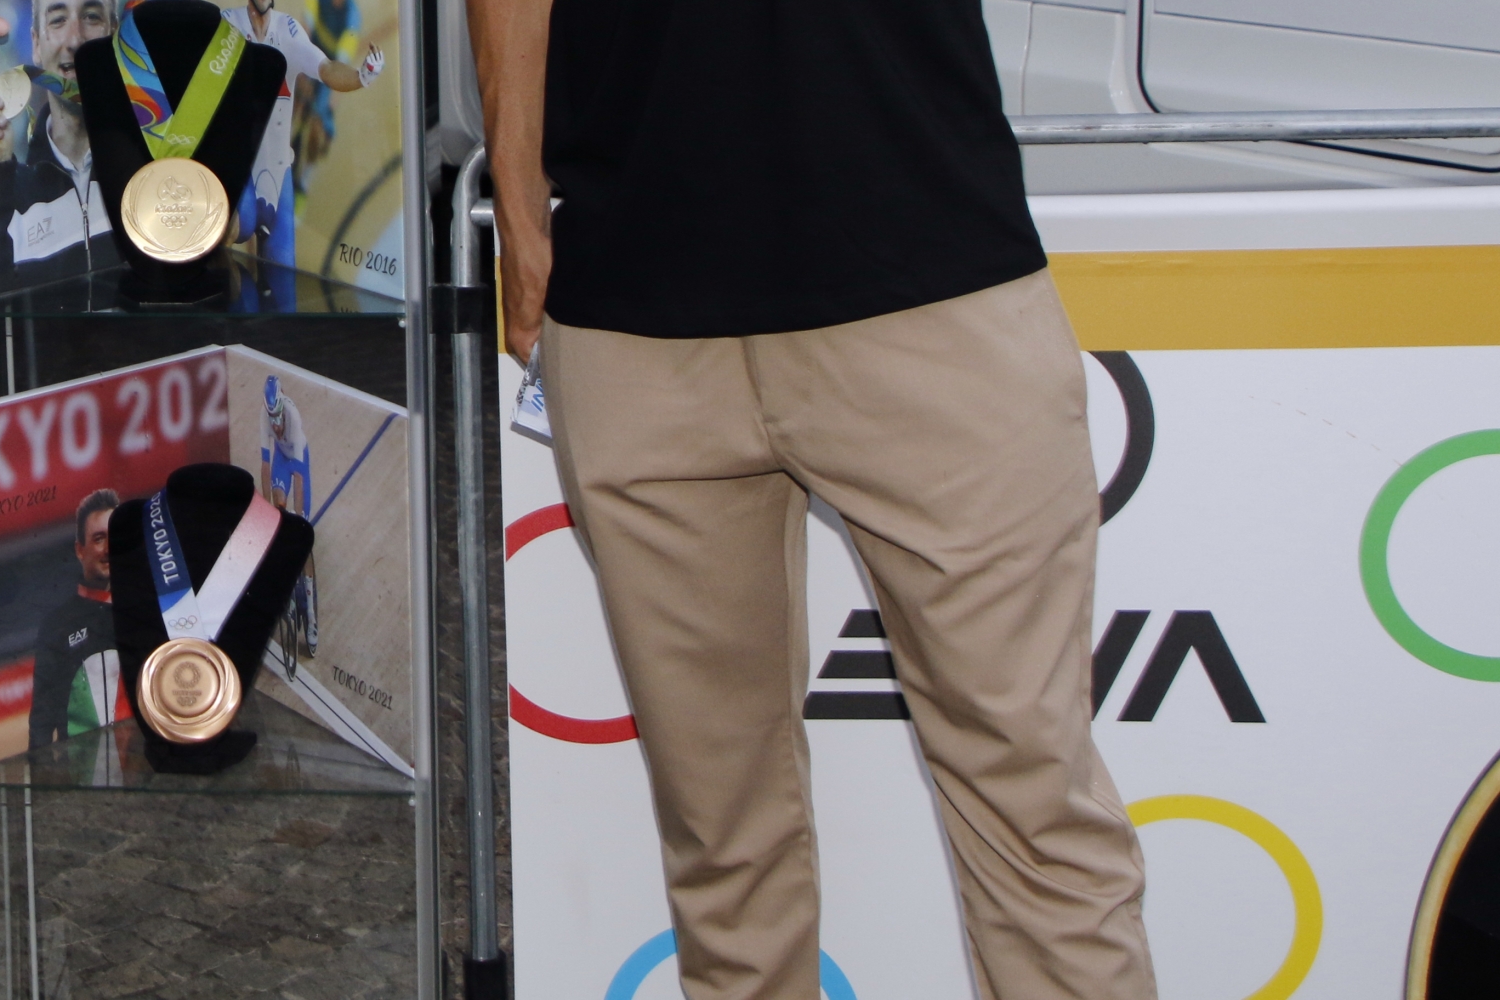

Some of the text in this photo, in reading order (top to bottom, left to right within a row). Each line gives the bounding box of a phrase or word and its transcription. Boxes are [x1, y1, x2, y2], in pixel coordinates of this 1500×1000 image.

[27, 216, 53, 243] EA7
[340, 243, 397, 276] RIO 2016
[153, 528, 180, 586] TOKYO
[333, 665, 393, 711] TOKYO 2021
